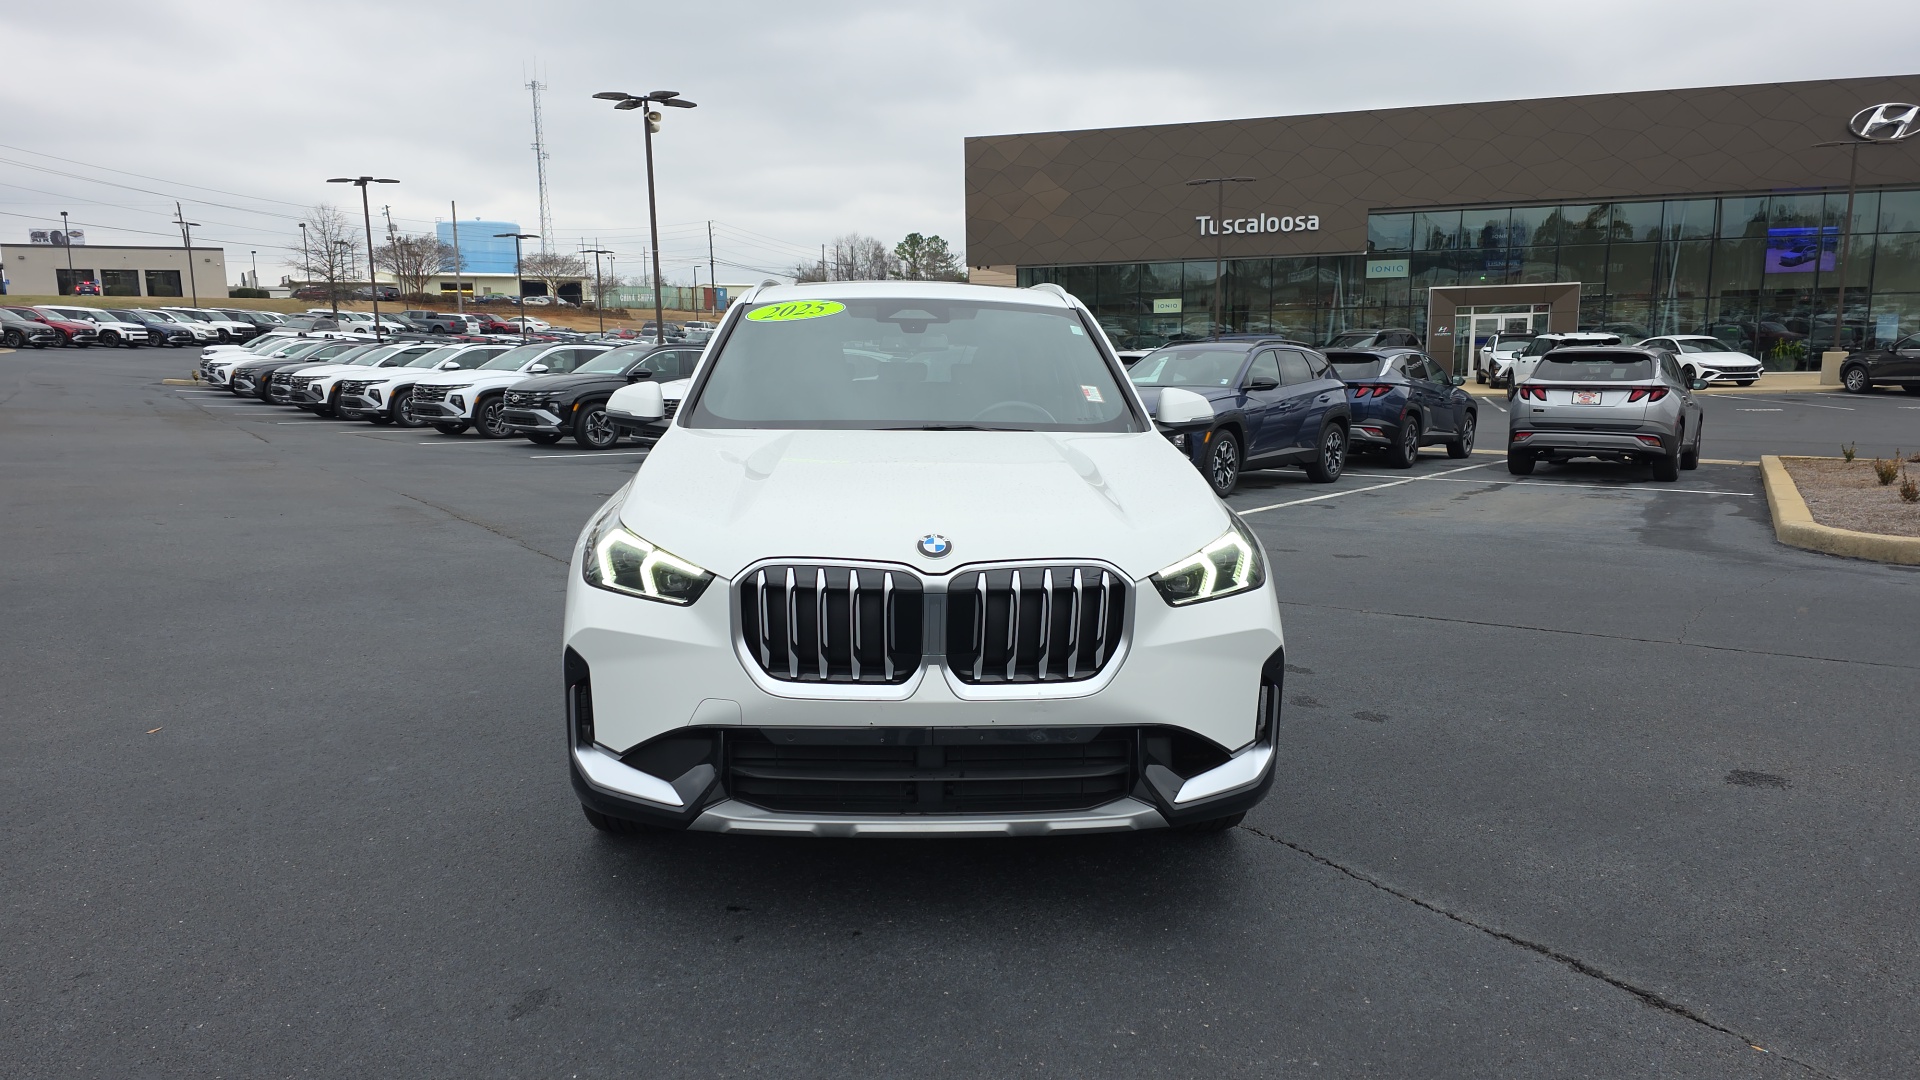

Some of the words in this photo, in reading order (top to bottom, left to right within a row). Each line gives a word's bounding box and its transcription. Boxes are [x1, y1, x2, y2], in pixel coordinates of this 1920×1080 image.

[1195, 212, 1319, 236] Tuscaloosa
[1371, 265, 1404, 273] IONIQ
[761, 302, 830, 320] 2025
